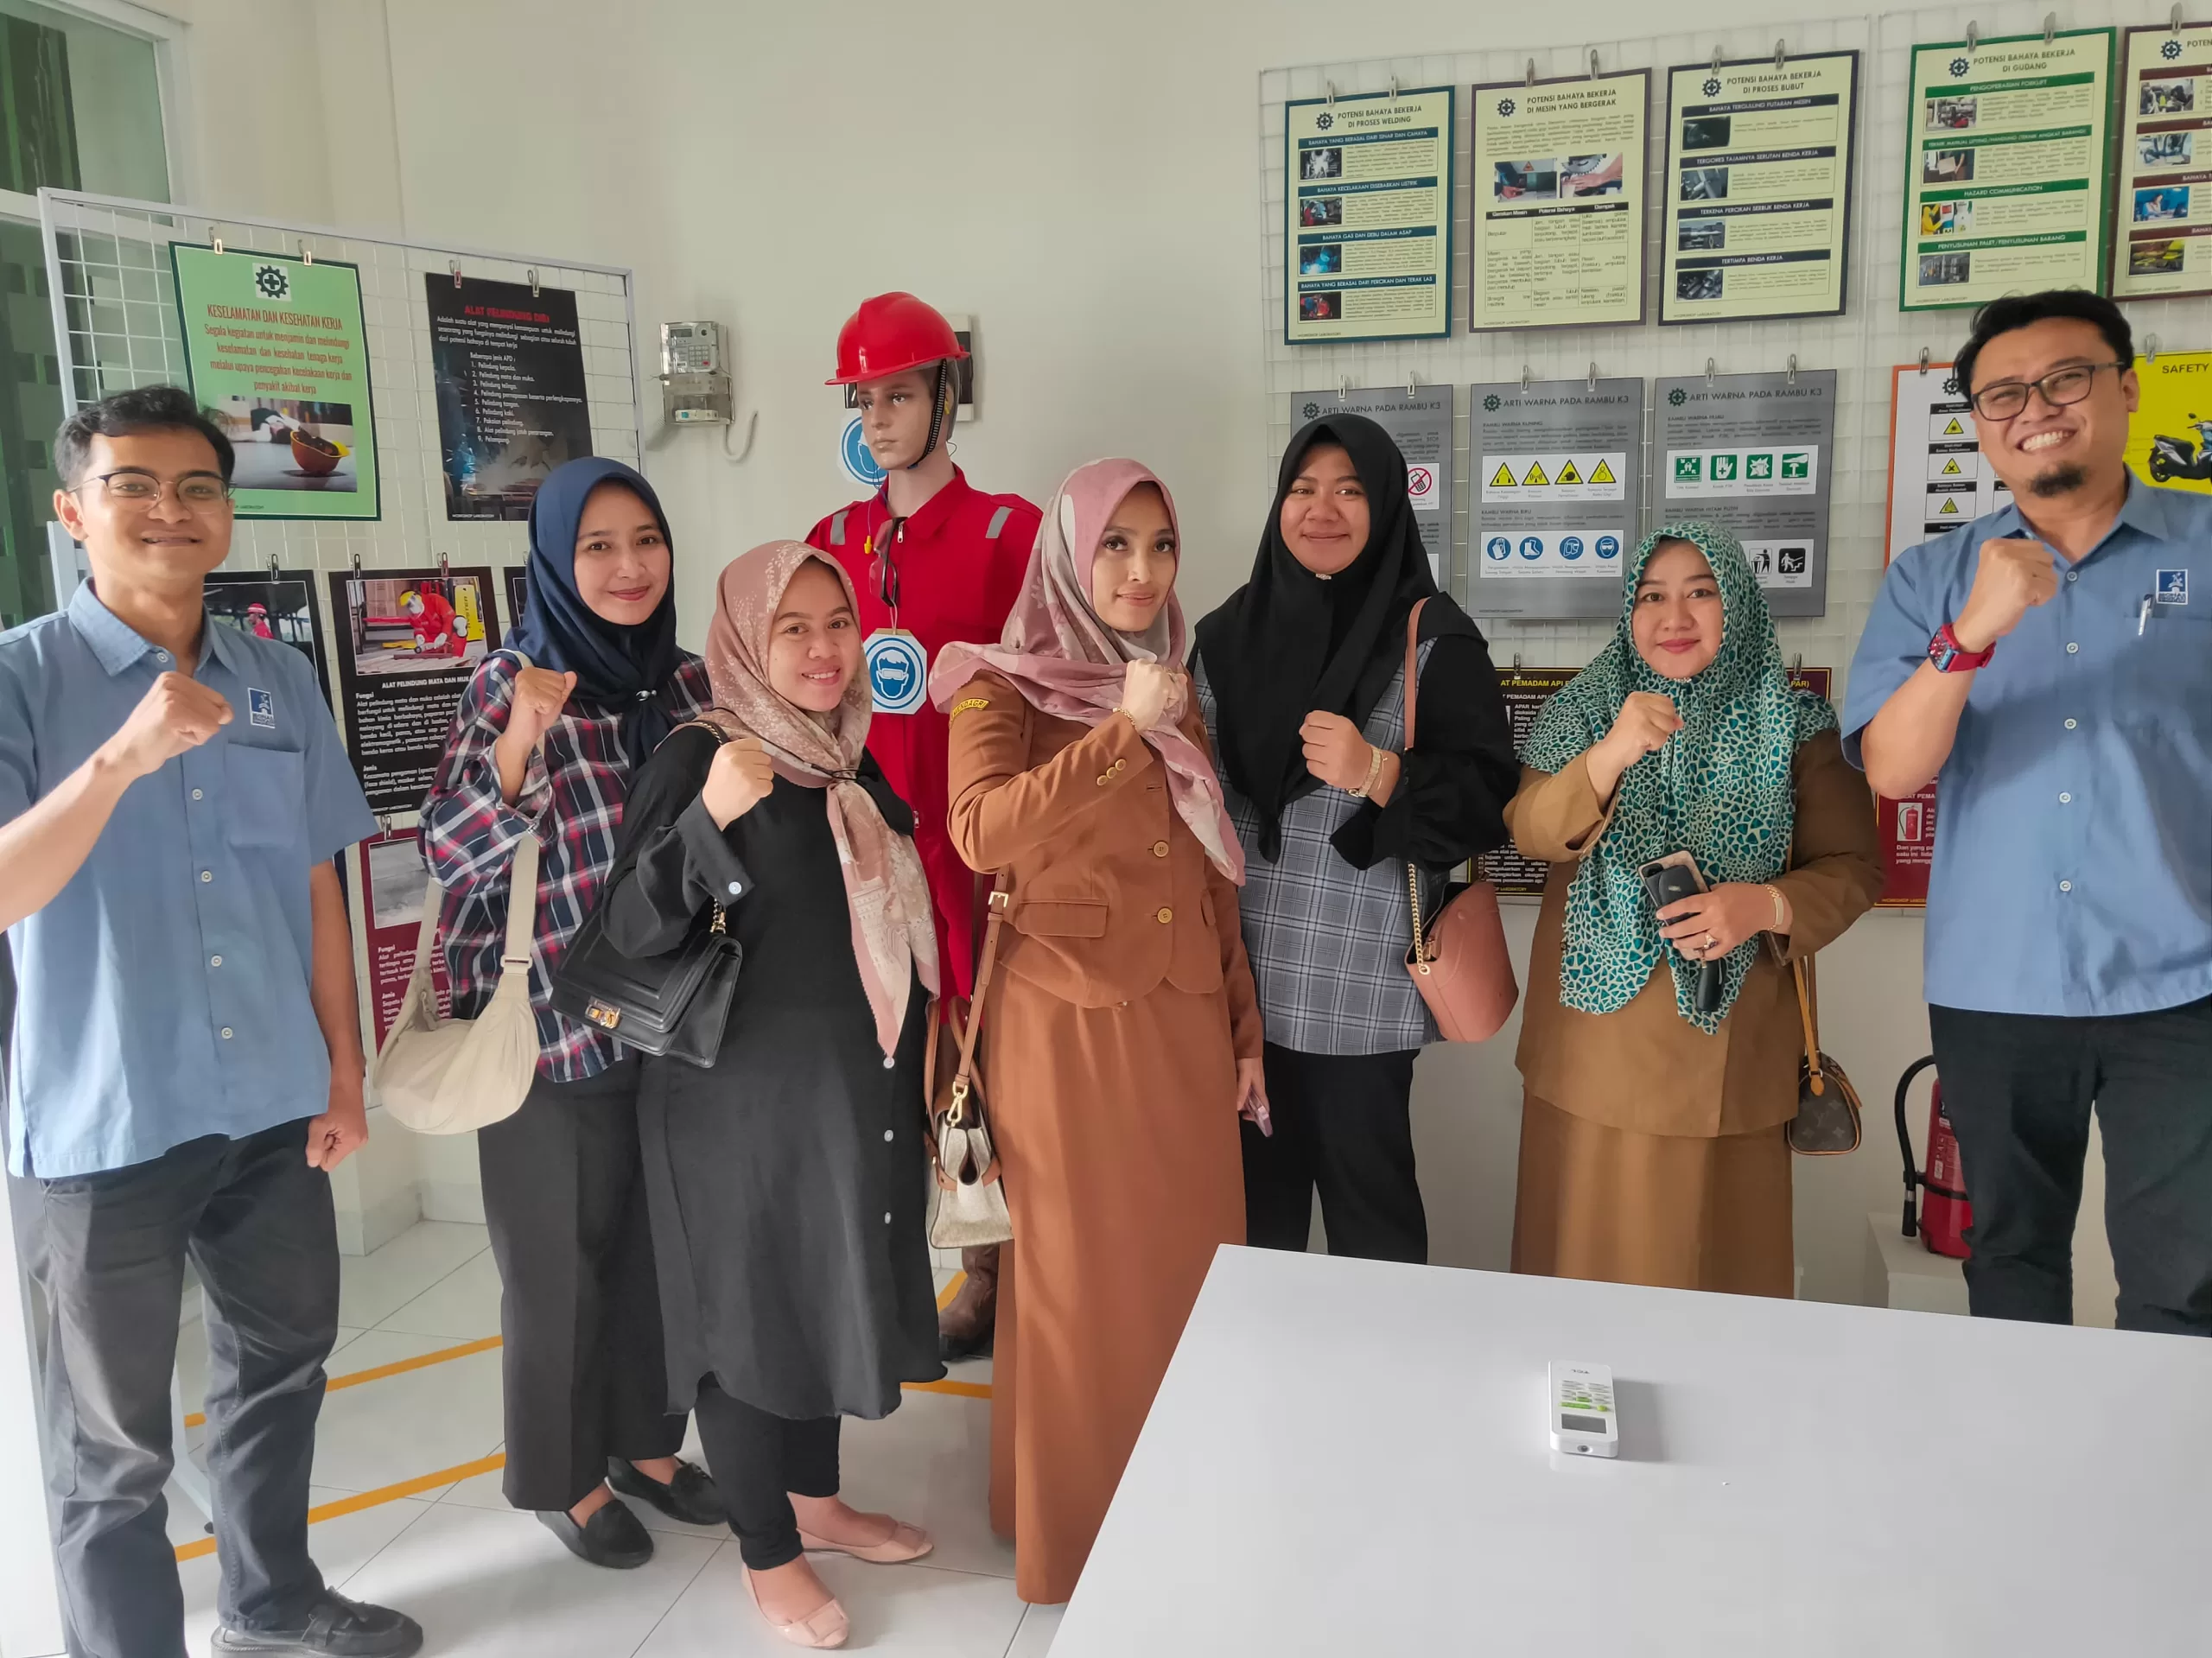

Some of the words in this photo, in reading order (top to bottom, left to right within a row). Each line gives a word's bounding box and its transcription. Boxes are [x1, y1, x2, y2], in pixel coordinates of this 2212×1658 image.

[1974, 55, 2005, 65] POTENSI
[2008, 53, 2039, 61] BAHAYA
[2042, 49, 2075, 59] BEKERJA
[1727, 76, 1757, 85] POTENSI
[1758, 73, 1788, 82] BAHAYA
[1790, 71, 1821, 79] BEKERJA
[1781, 82, 1804, 91] BUBUT
[1557, 92, 1584, 101] BAHAYA
[1587, 89, 1616, 98] BEKERJA
[1580, 99, 1616, 109] BERGERAK
[1395, 105, 1421, 114] BEKERJA
[1357, 118, 1380, 127] PROSES
[207, 304, 260, 321] KESELAMATAN
[263, 310, 278, 323] DAN
[280, 311, 321, 327] KESEHATAN
[322, 316, 342, 330] KERJA
[205, 324, 226, 337] Segala
[305, 336, 316, 345] dan
[260, 346, 270, 356] dan
[2162, 363, 2209, 374] SAFETY
[1618, 395, 1629, 403] K3
[1712, 391, 1745, 400] WARNA
[397, 679, 427, 688] PELINDUNG
[1791, 680, 1809, 689] PAR)
